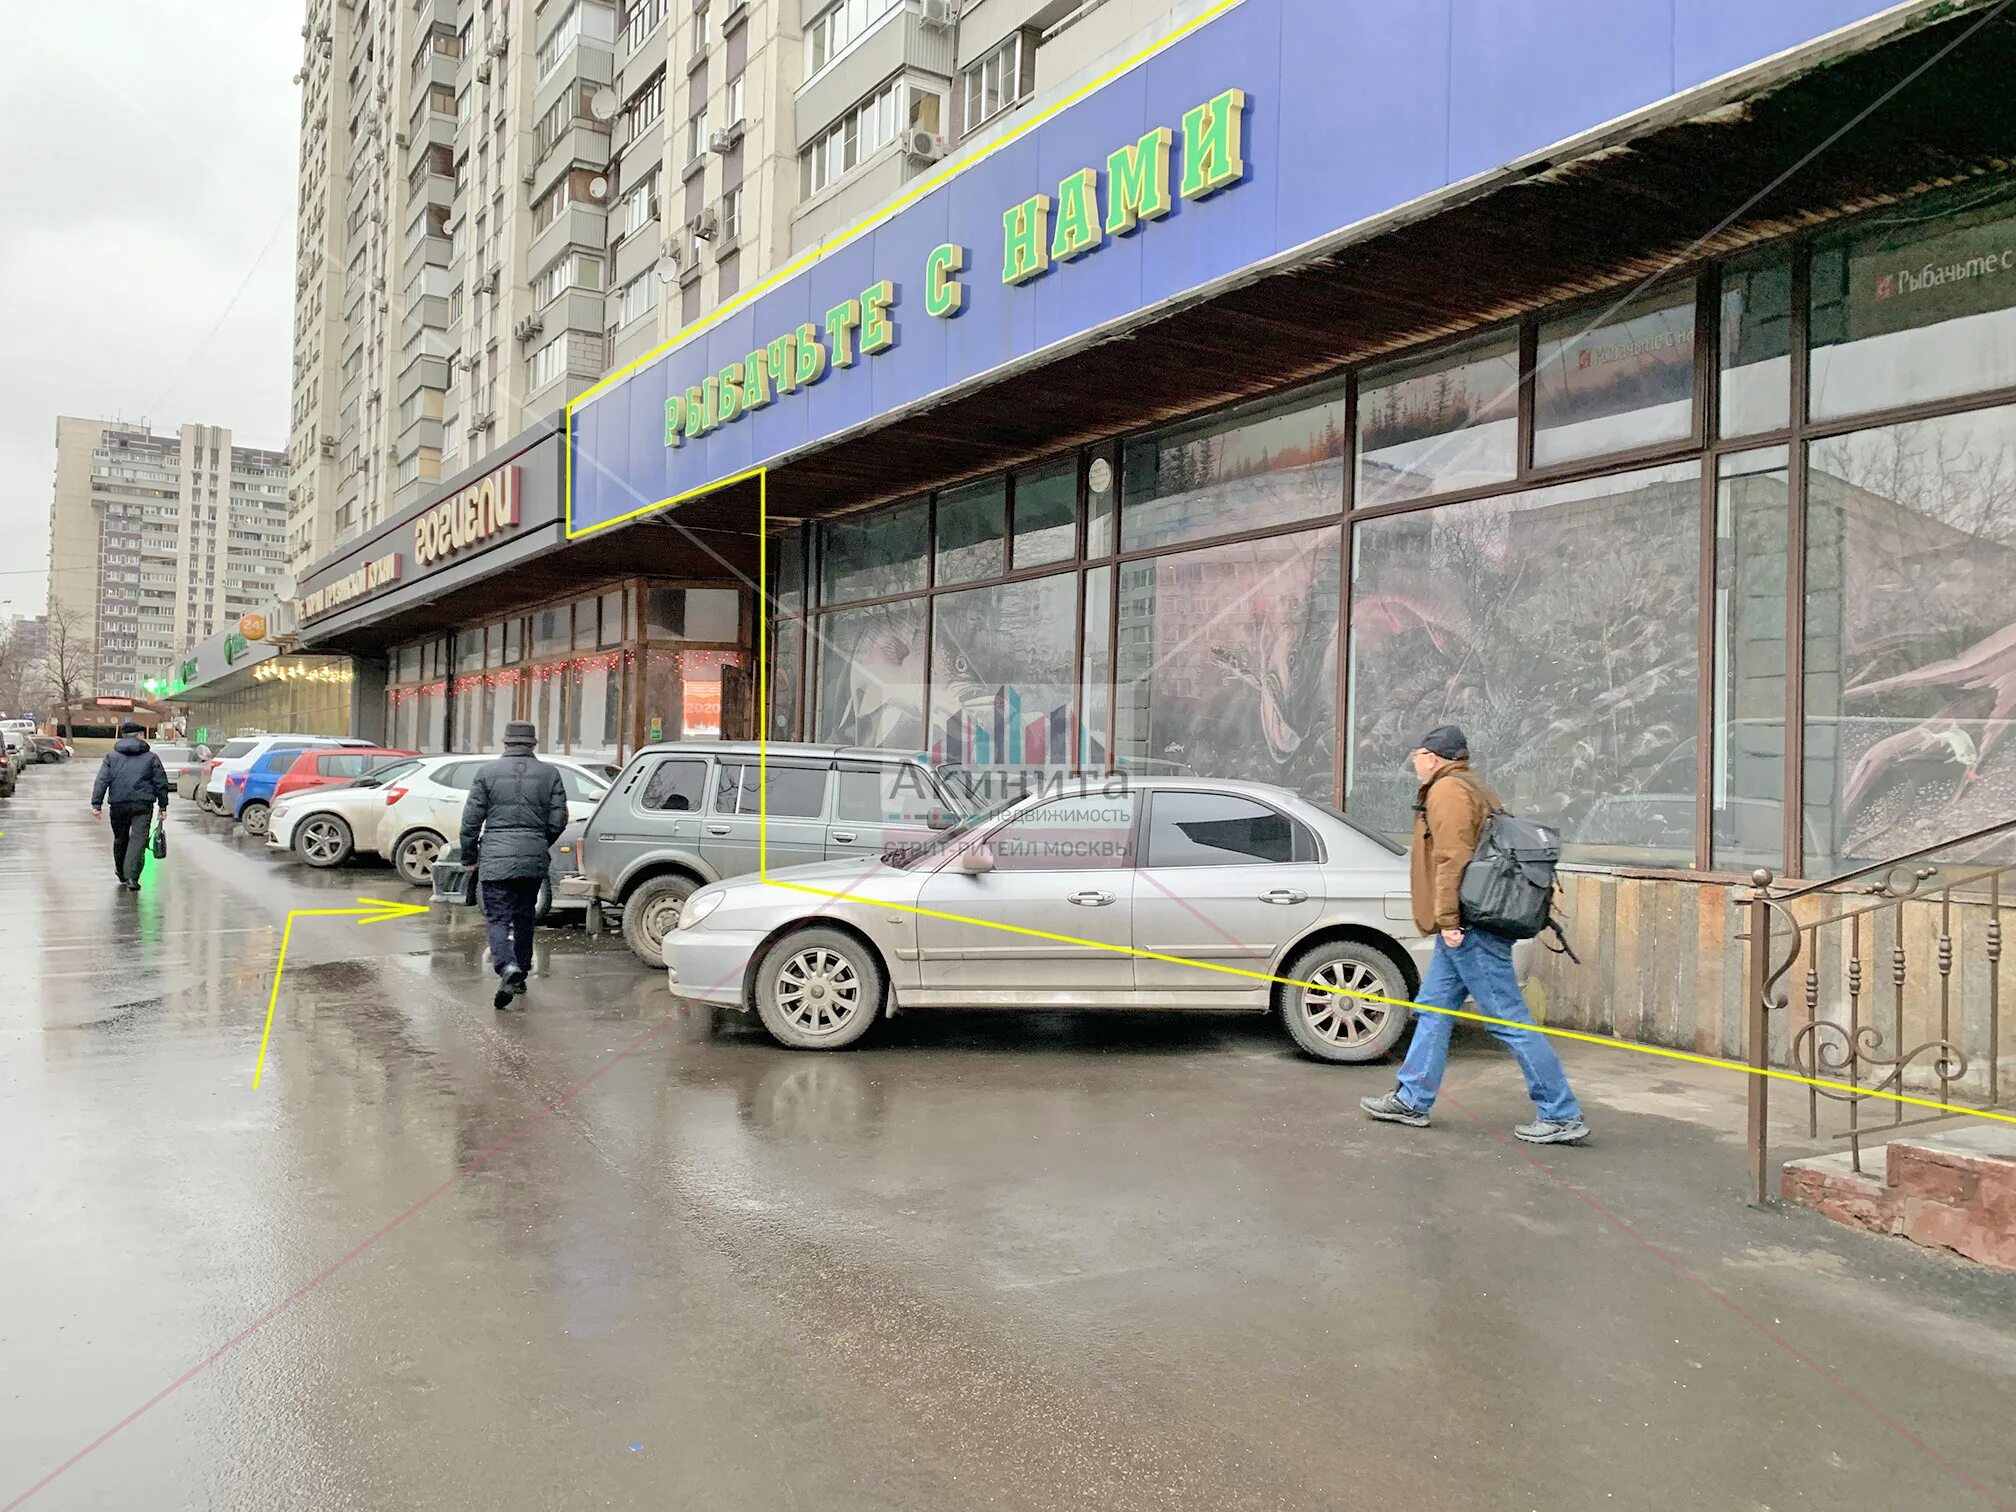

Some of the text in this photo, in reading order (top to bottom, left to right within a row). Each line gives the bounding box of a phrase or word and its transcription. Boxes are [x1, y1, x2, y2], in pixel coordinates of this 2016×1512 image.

[664, 88, 1245, 447] РЫБАЧЬТЕ С НАМИ
[1898, 254, 1998, 294] Рыбачьте
